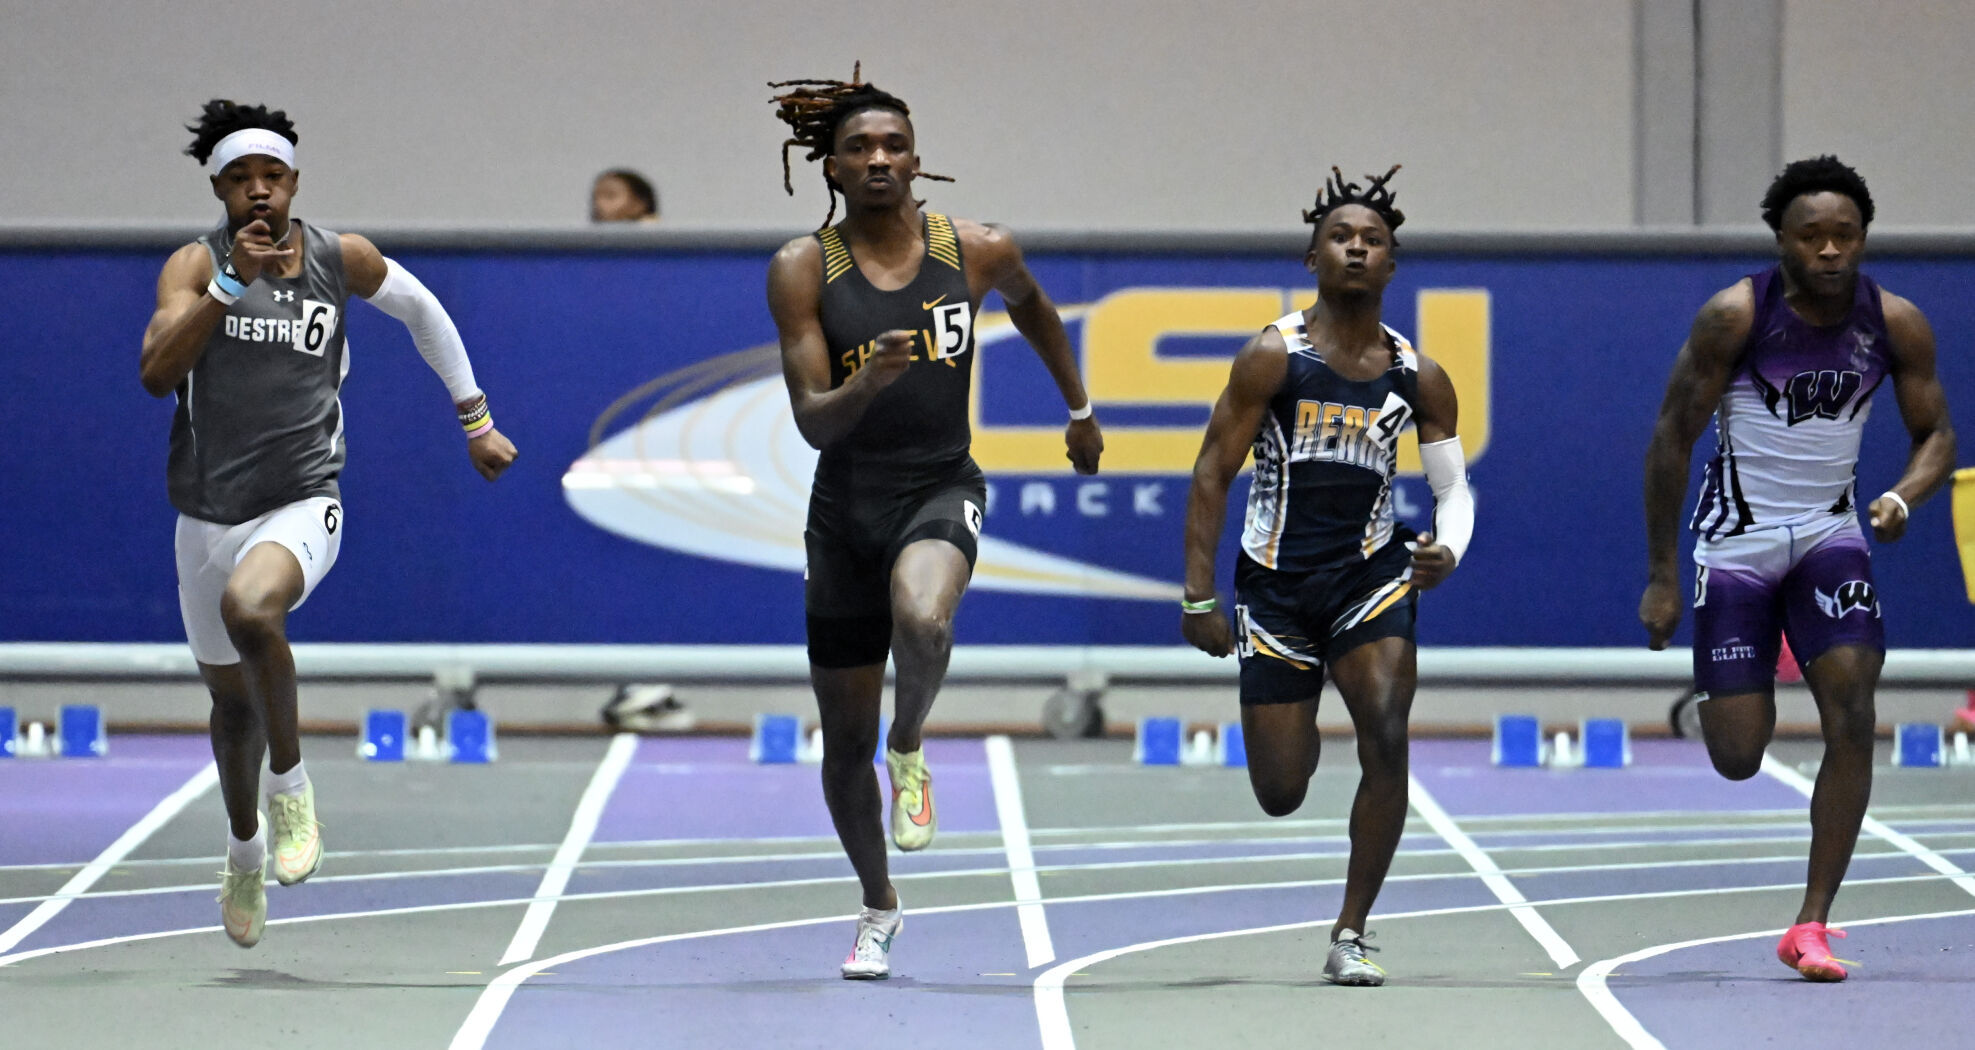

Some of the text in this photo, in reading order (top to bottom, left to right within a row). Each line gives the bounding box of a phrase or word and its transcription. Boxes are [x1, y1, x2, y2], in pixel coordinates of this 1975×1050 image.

[304, 306, 328, 351] 6
[944, 307, 964, 354] 5
[1788, 370, 1863, 427] W
[1376, 405, 1408, 442] 4
[324, 503, 341, 535] 6
[1711, 645, 1756, 662] ELITE
